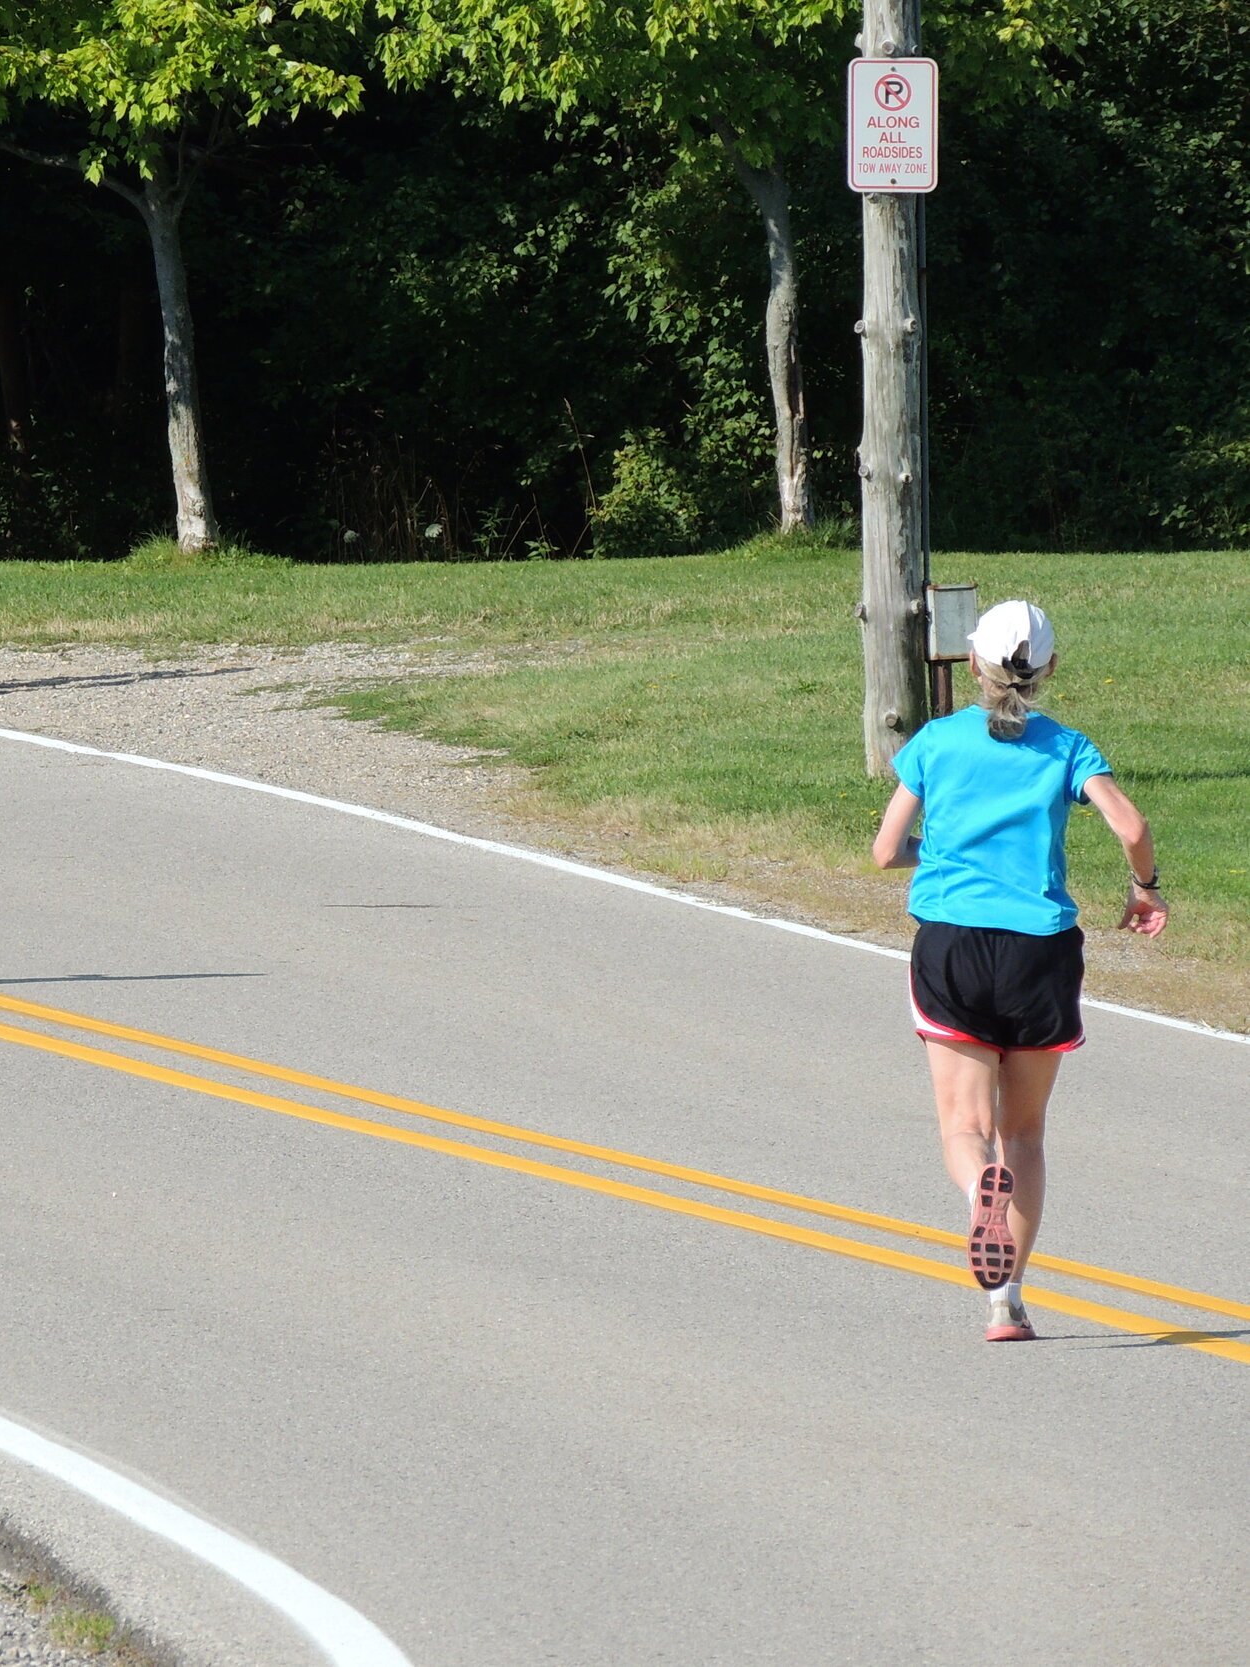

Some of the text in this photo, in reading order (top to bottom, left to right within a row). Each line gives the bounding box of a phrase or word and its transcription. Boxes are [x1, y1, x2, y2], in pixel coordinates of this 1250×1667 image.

[884, 80, 904, 104] P
[866, 116, 920, 128] ALONG
[878, 132, 907, 143] ALL
[862, 146, 923, 159] ROADSIDES
[858, 163, 928, 174] TOW AWAY ZONE
